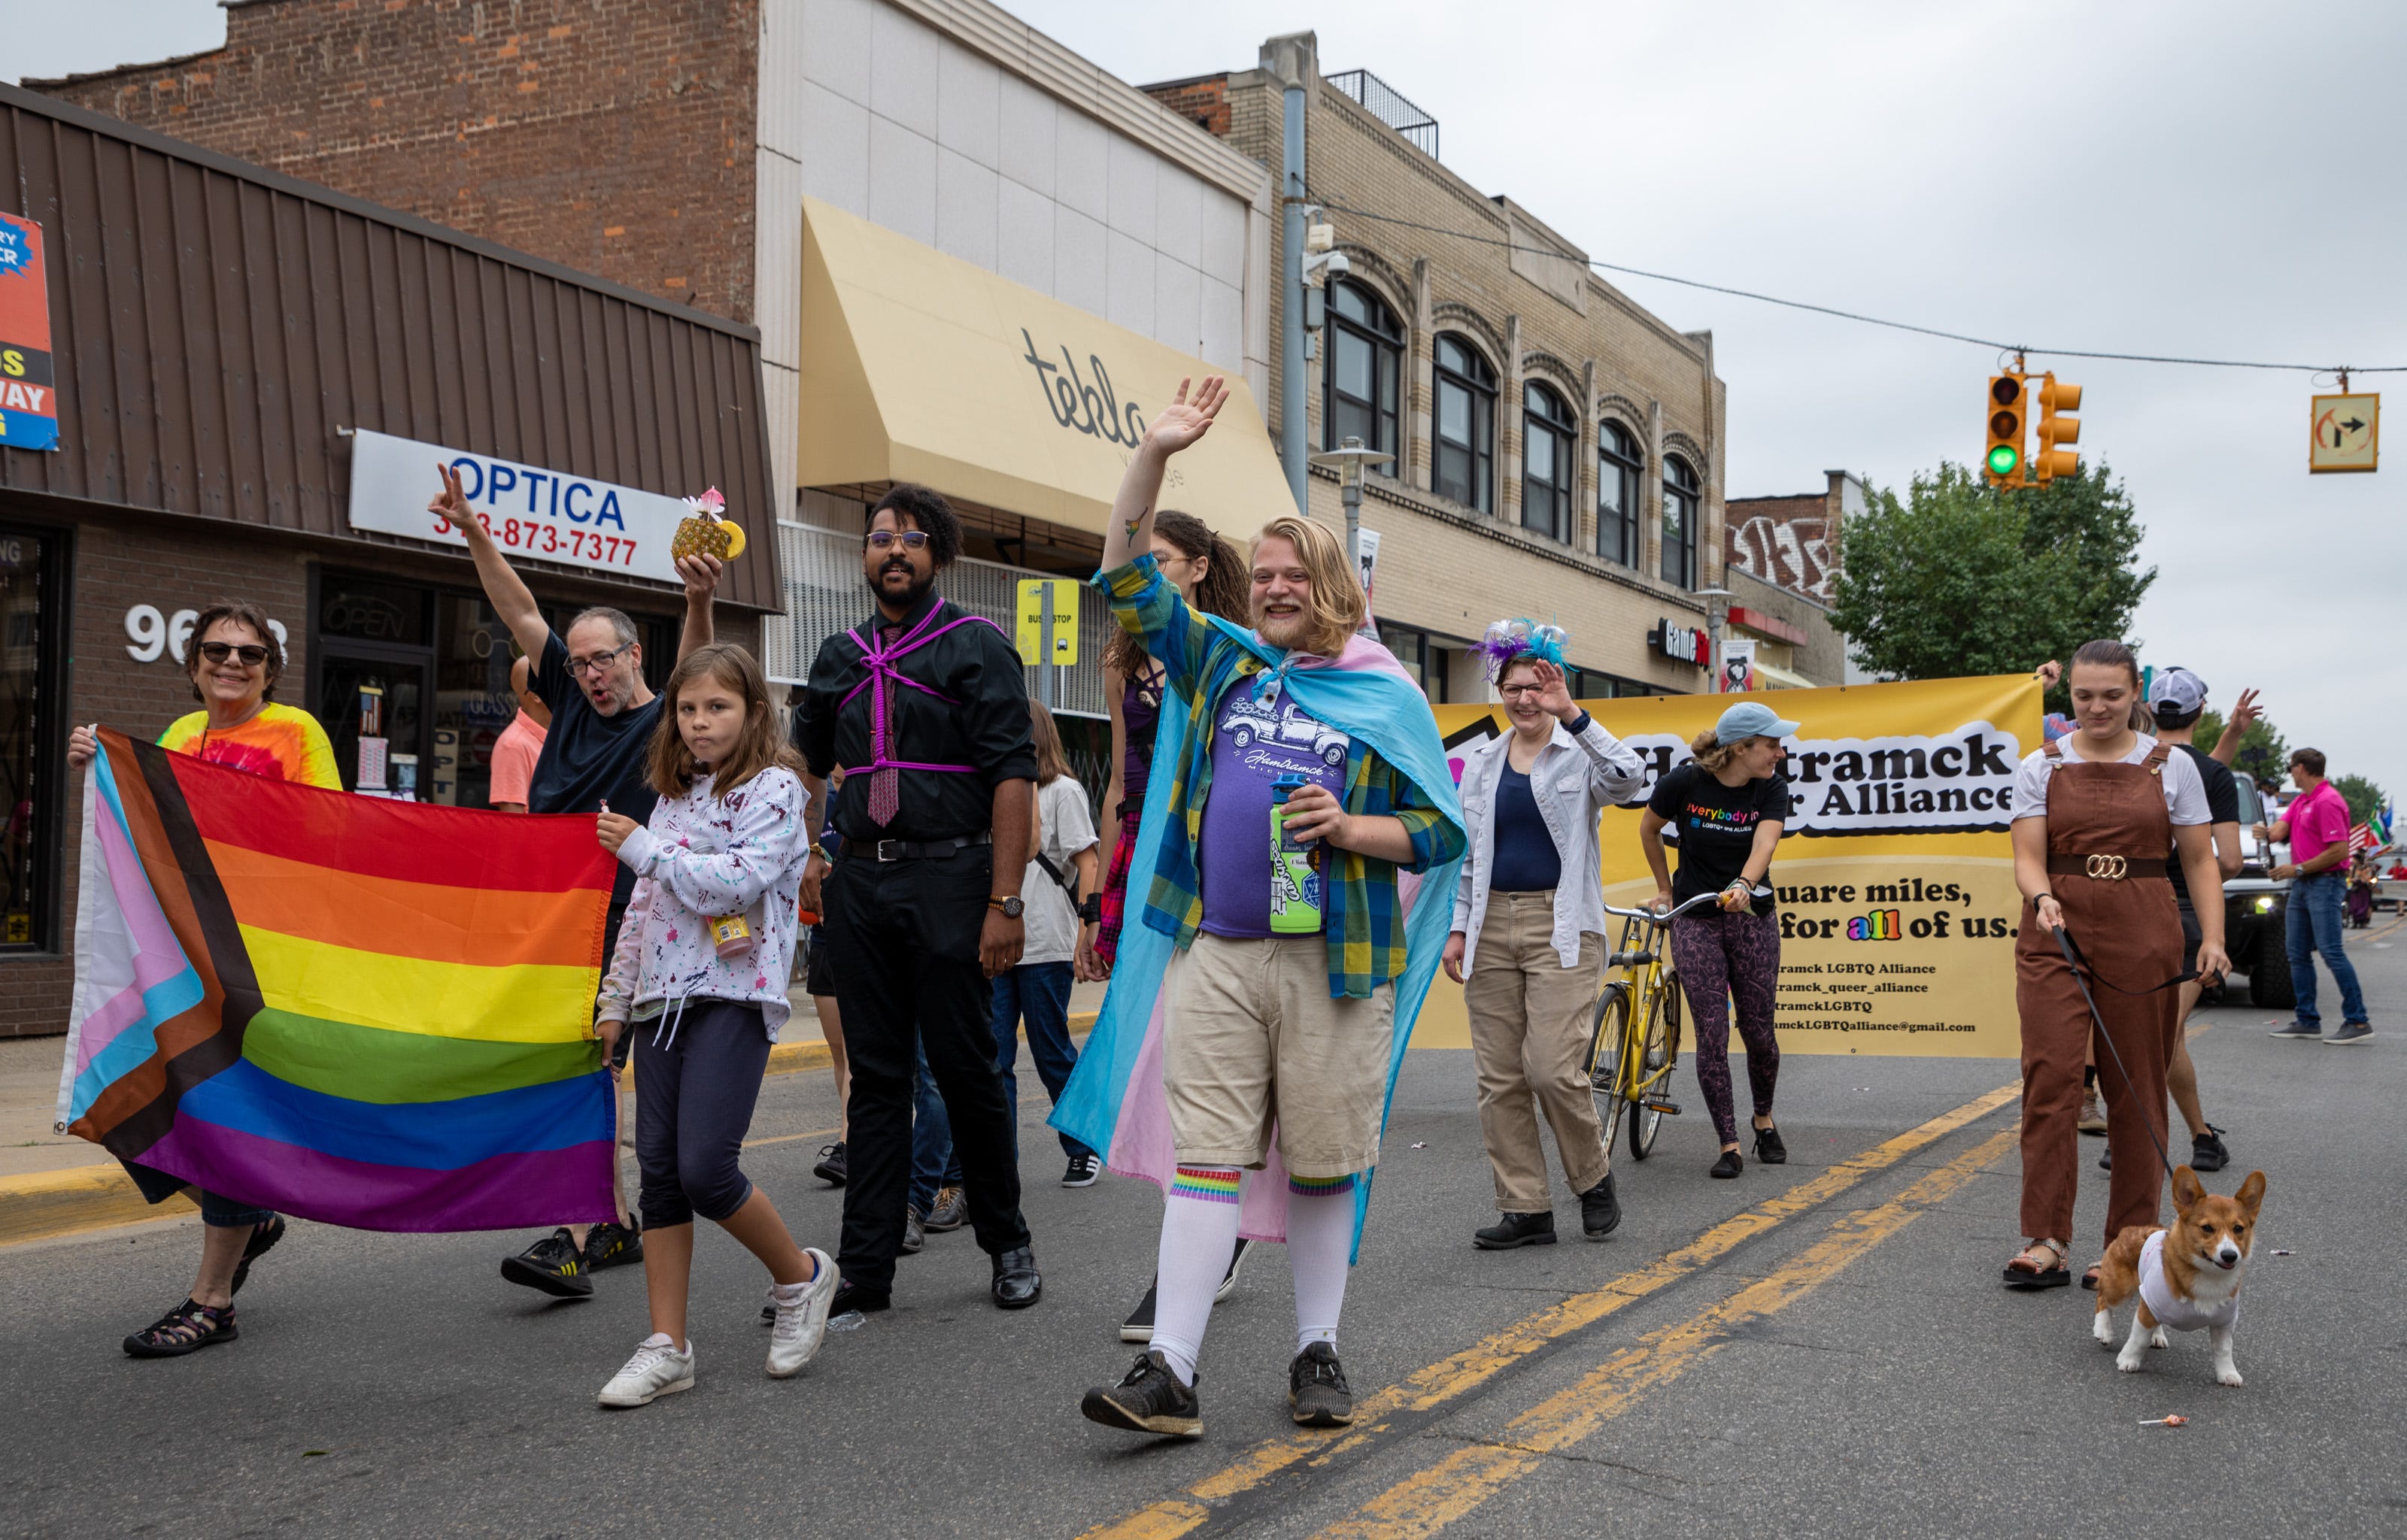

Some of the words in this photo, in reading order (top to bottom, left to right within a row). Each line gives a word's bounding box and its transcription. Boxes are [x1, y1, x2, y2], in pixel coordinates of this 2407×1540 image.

[1021, 327, 1146, 449] tekla
[449, 457, 625, 532] OPTICA
[433, 513, 637, 565] 33-873-7377
[326, 604, 406, 638] OPEN
[1027, 614, 1042, 623] BUS
[1053, 614, 1072, 623] STOP
[124, 604, 289, 668] 96
[1665, 618, 1710, 666] GameSt
[1245, 750, 1327, 775] Hamtramck
[1249, 765, 1322, 784] MICHAN
[1633, 733, 2012, 788] Htramck
[1817, 782, 2012, 817] Alliance
[1776, 884, 1856, 903] uare
[1865, 878, 1971, 907] miles,
[1780, 912, 1840, 938] for
[1847, 909, 1902, 941] all
[1909, 911, 1950, 938] of
[1961, 917, 2019, 938] us.
[1777, 964, 1823, 974] ramck
[1828, 964, 1875, 975] LGBTQ
[1878, 964, 1936, 974] Alliance
[1776, 983, 1929, 994] ramck_queer_alliance
[1775, 1002, 1872, 1013] tramckLGBTQ
[1735, 1020, 1976, 1033] amckLGBTQalliance@gmail.com
